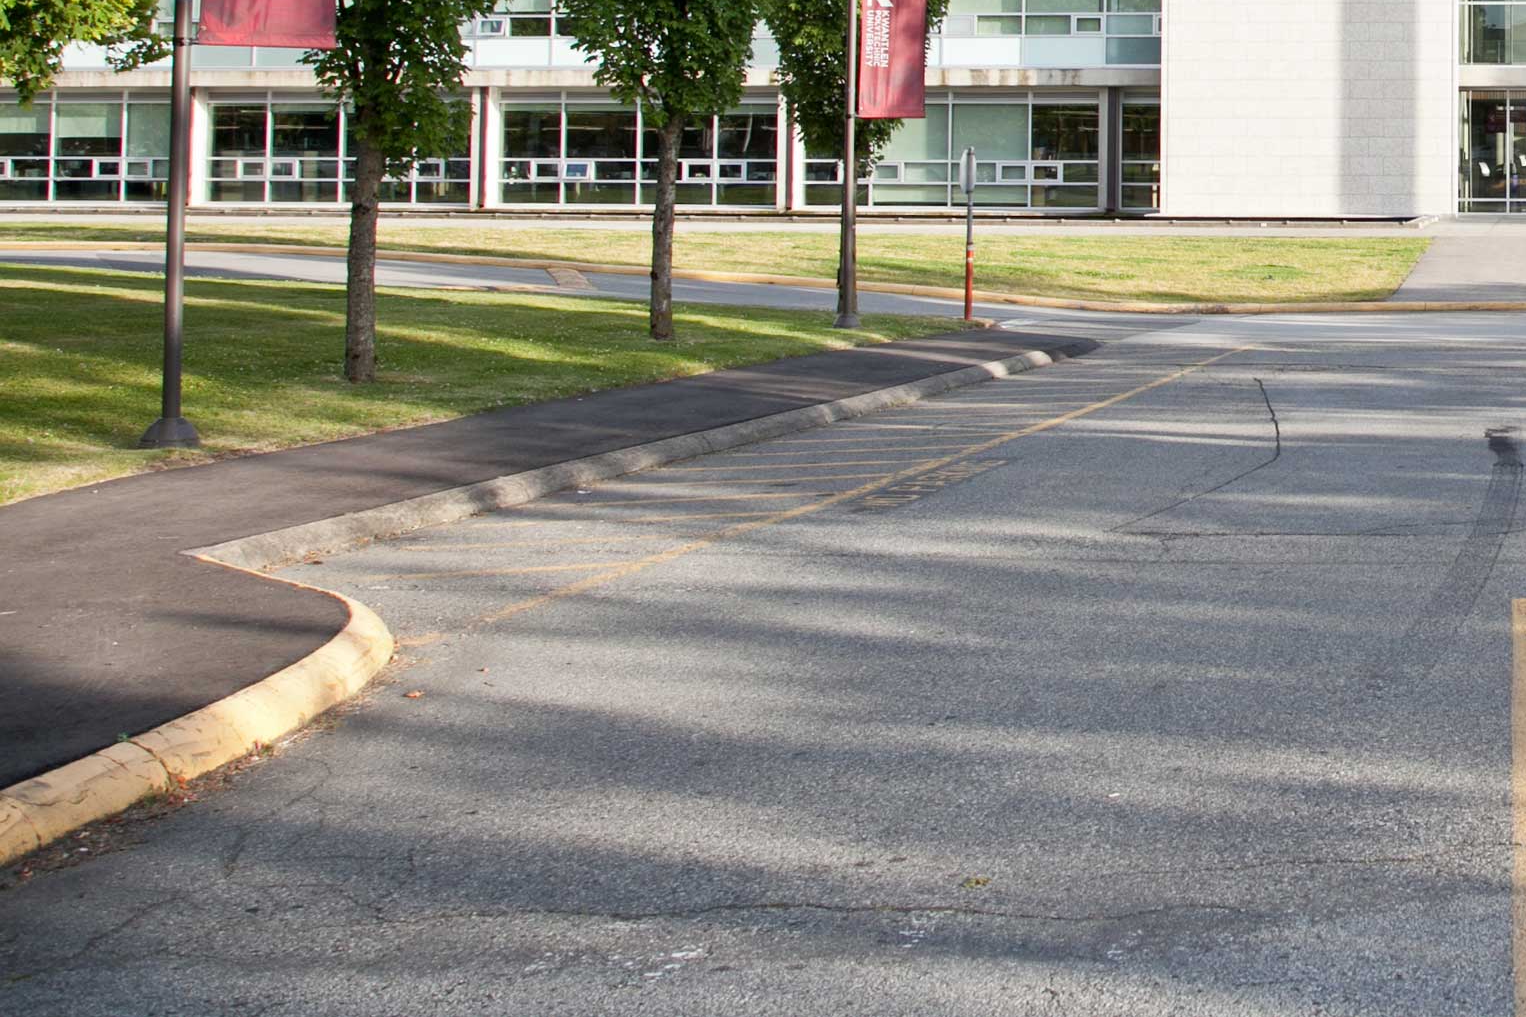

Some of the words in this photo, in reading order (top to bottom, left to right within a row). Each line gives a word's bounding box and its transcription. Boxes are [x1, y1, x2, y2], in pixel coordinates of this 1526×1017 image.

[865, 9, 874, 67] UNIVERSITY
[873, 9, 881, 67] POLYTECHNIC
[880, 9, 890, 68] KWANTLEN
